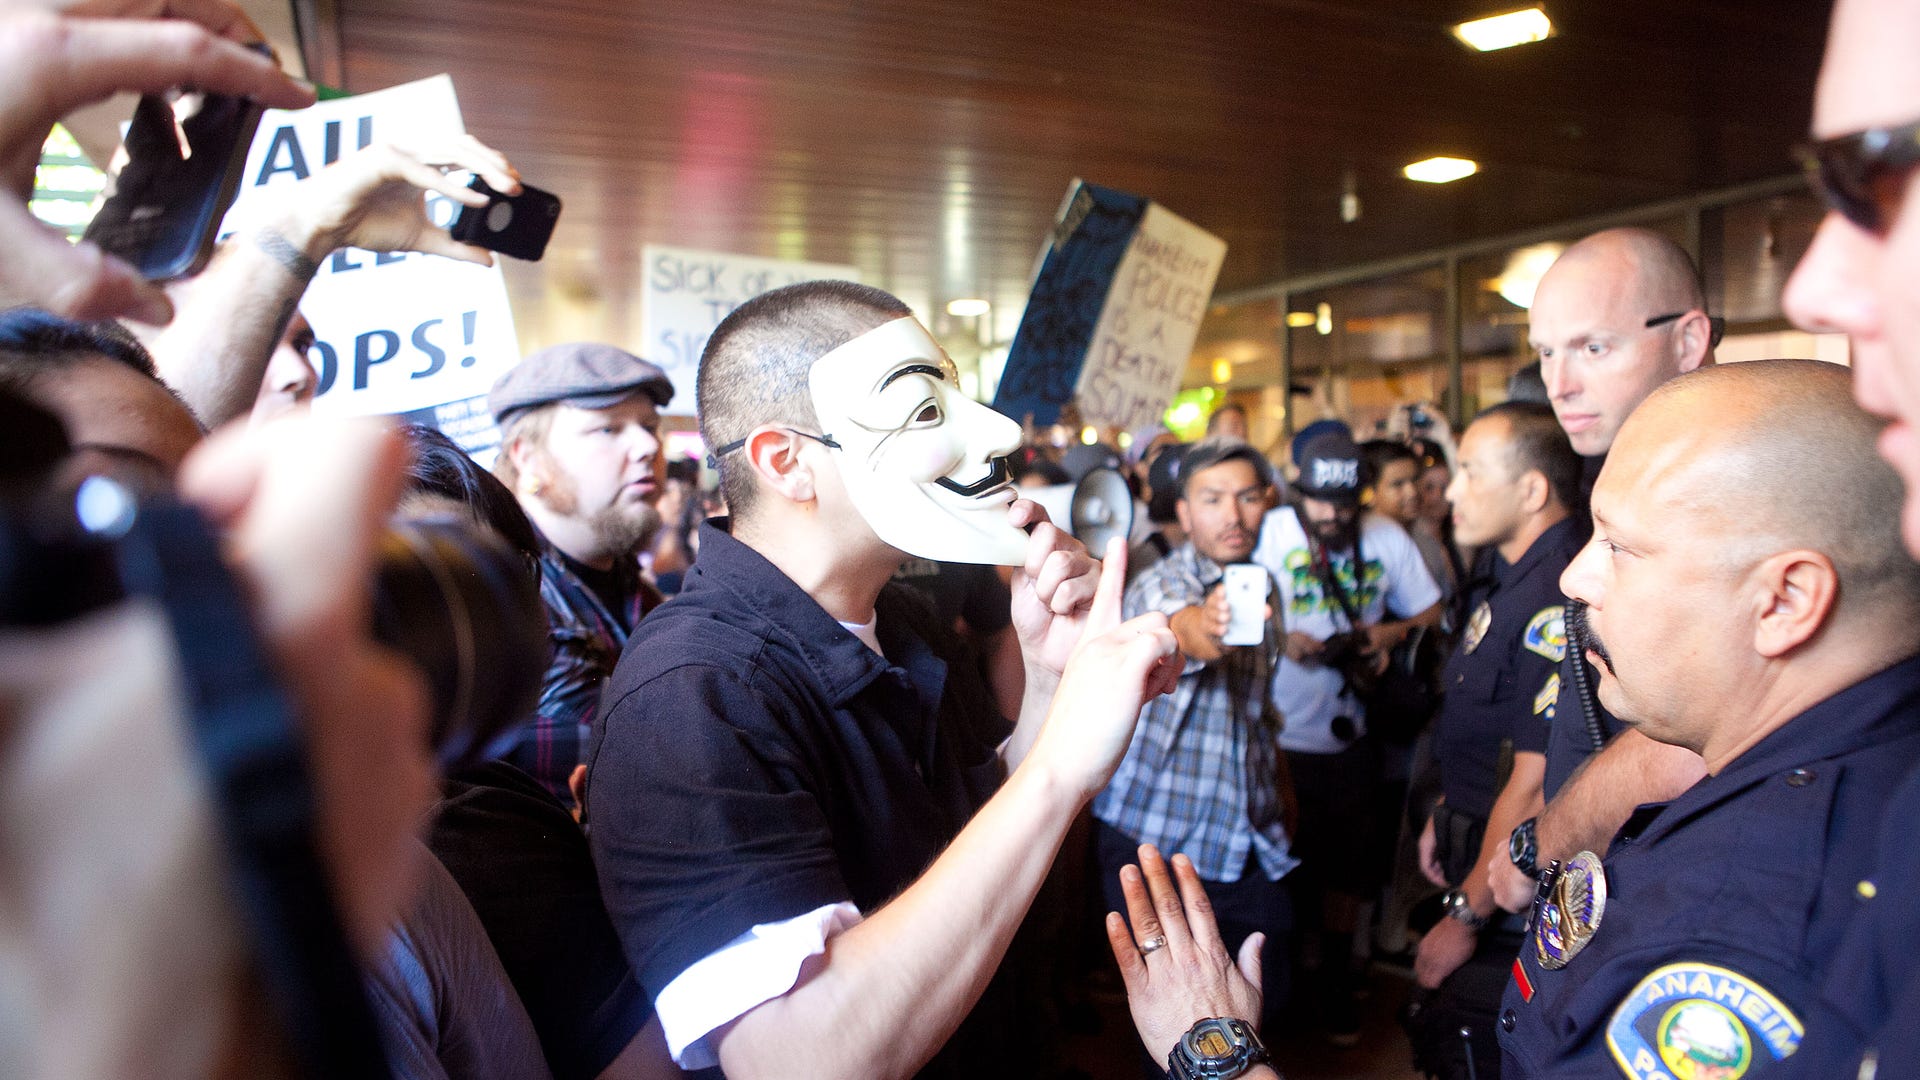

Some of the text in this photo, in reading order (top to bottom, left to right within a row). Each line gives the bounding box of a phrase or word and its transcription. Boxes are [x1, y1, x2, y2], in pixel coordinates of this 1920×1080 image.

[651, 254, 728, 294] SICK
[1127, 260, 1204, 325] POLICE
[1101, 336, 1174, 387] DEATH
[1647, 972, 1799, 1060] ANAHEIM
